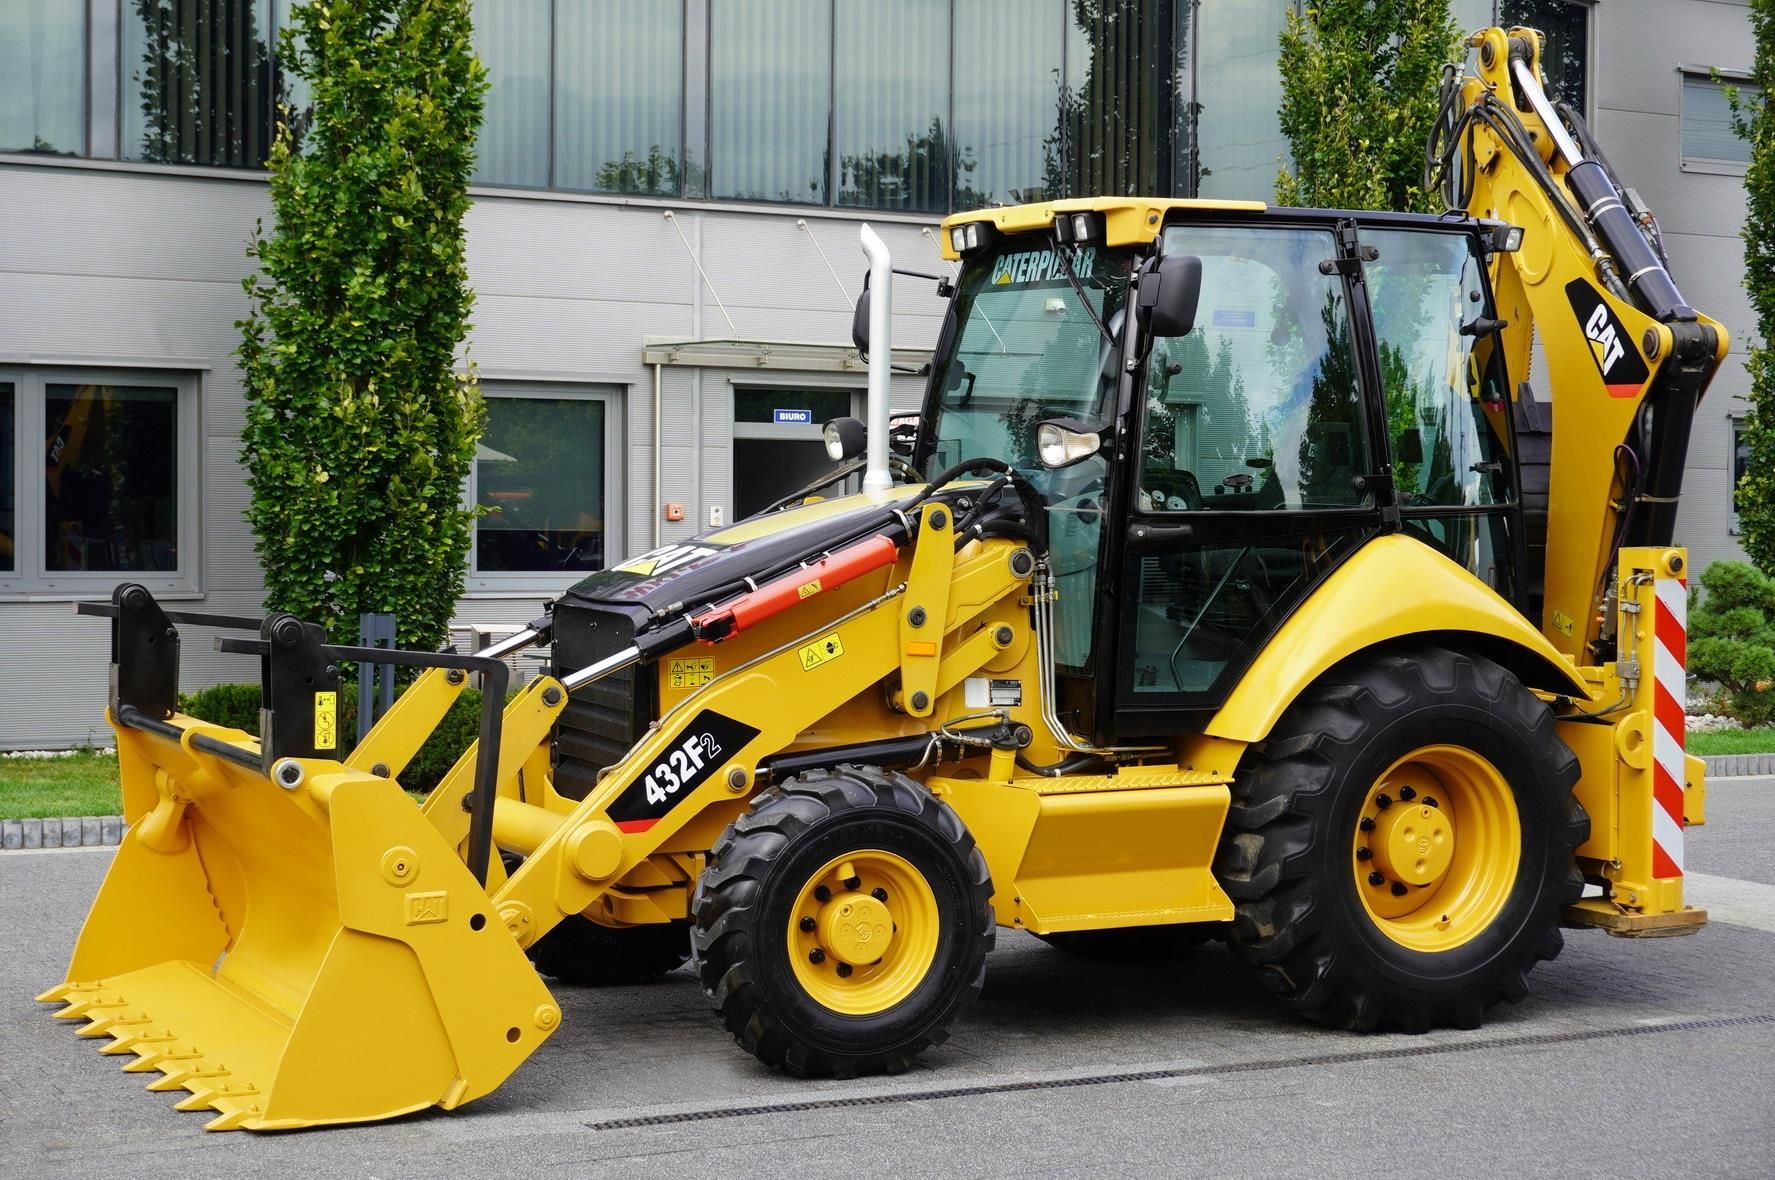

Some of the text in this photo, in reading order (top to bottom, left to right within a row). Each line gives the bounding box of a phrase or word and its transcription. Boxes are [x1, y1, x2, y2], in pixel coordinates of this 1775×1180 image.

[991, 246, 1096, 285] CATERPILAR
[1585, 303, 1625, 376] CAT
[779, 412, 806, 421] BIURO
[611, 544, 719, 577] CAT
[643, 732, 723, 806] 432F2
